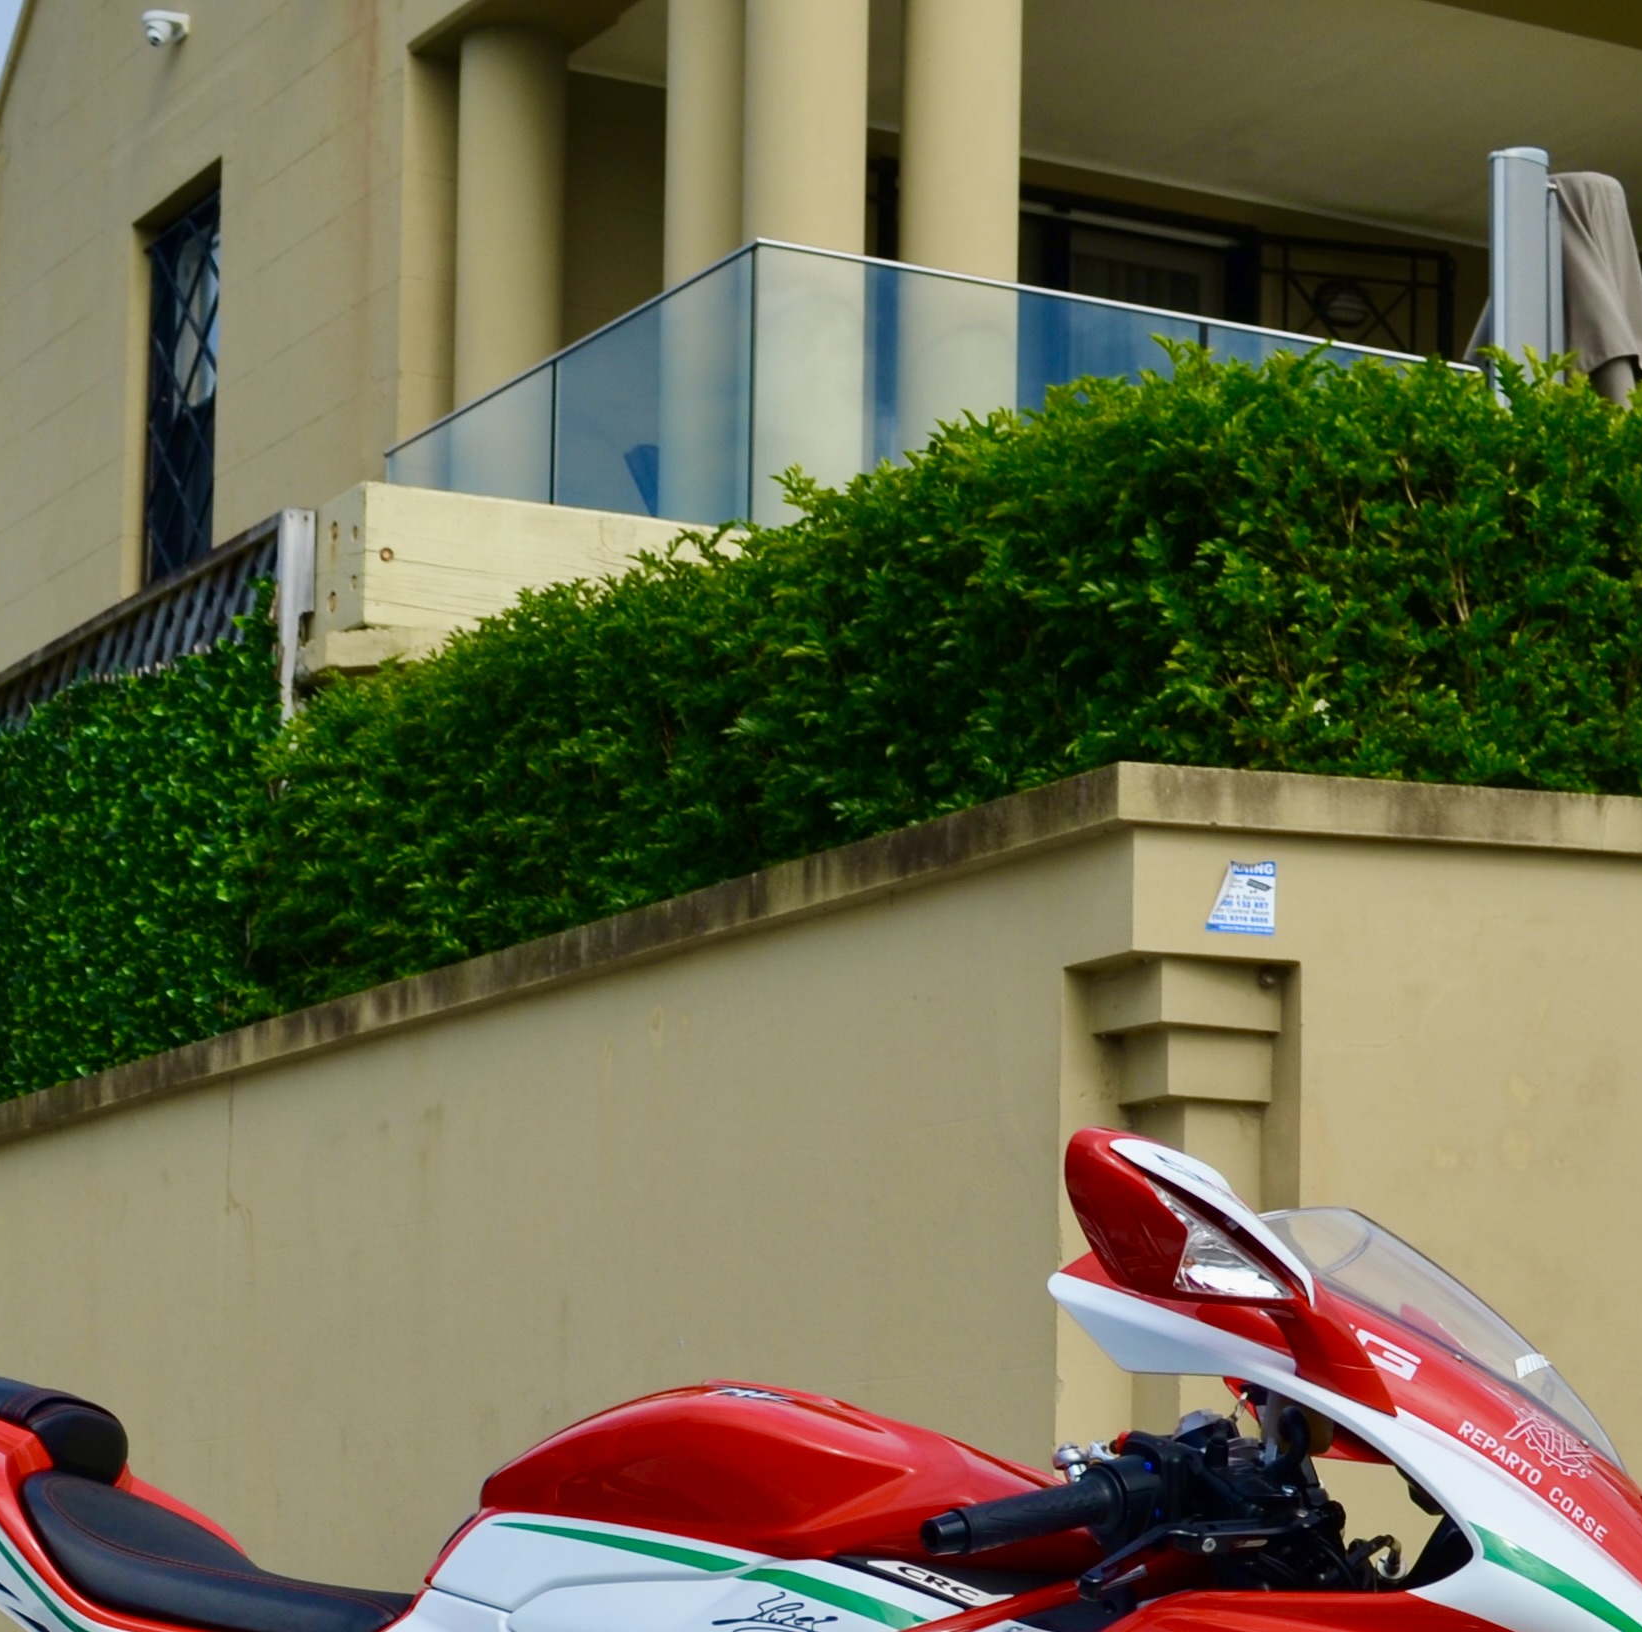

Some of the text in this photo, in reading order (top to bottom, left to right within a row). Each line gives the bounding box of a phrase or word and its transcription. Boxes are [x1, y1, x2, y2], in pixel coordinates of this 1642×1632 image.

[1457, 1419, 1609, 1544] REPARTO CORSE
[897, 1565, 984, 1602] CRC
